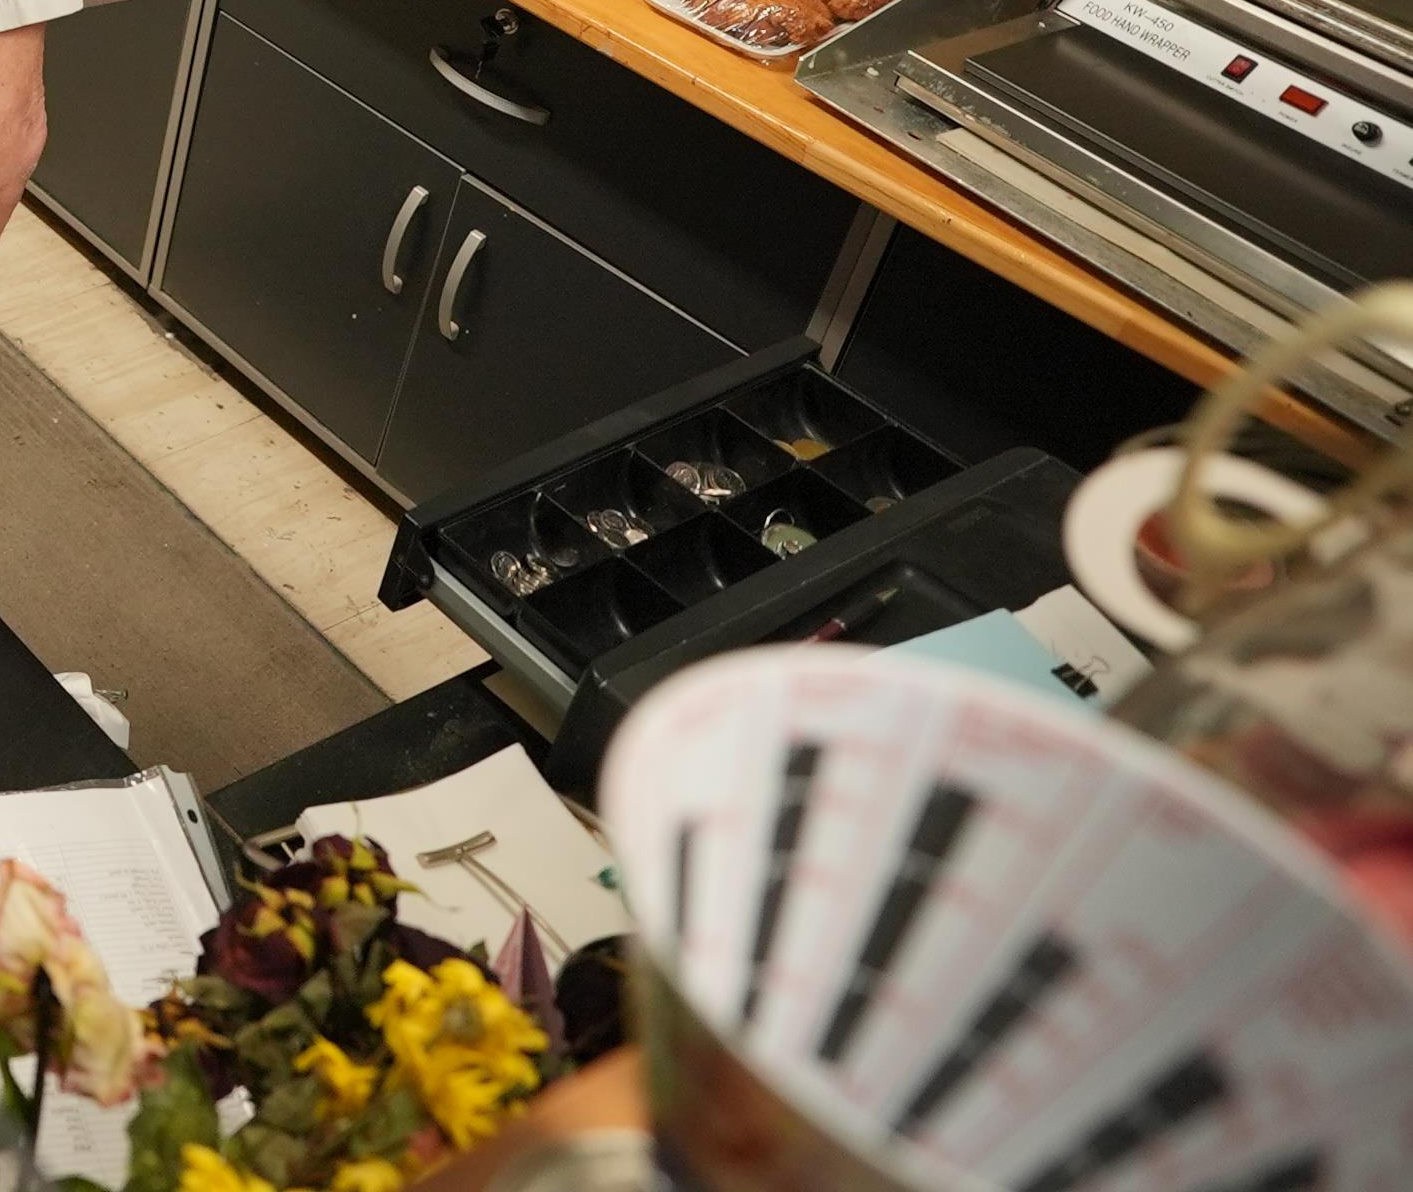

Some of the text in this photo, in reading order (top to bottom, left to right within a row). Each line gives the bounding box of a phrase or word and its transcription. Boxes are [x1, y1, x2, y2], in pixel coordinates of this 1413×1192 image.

[1082, 0, 1192, 62] FOOD HAND WRAPPER
[1123, 1, 1174, 33] KW-450
